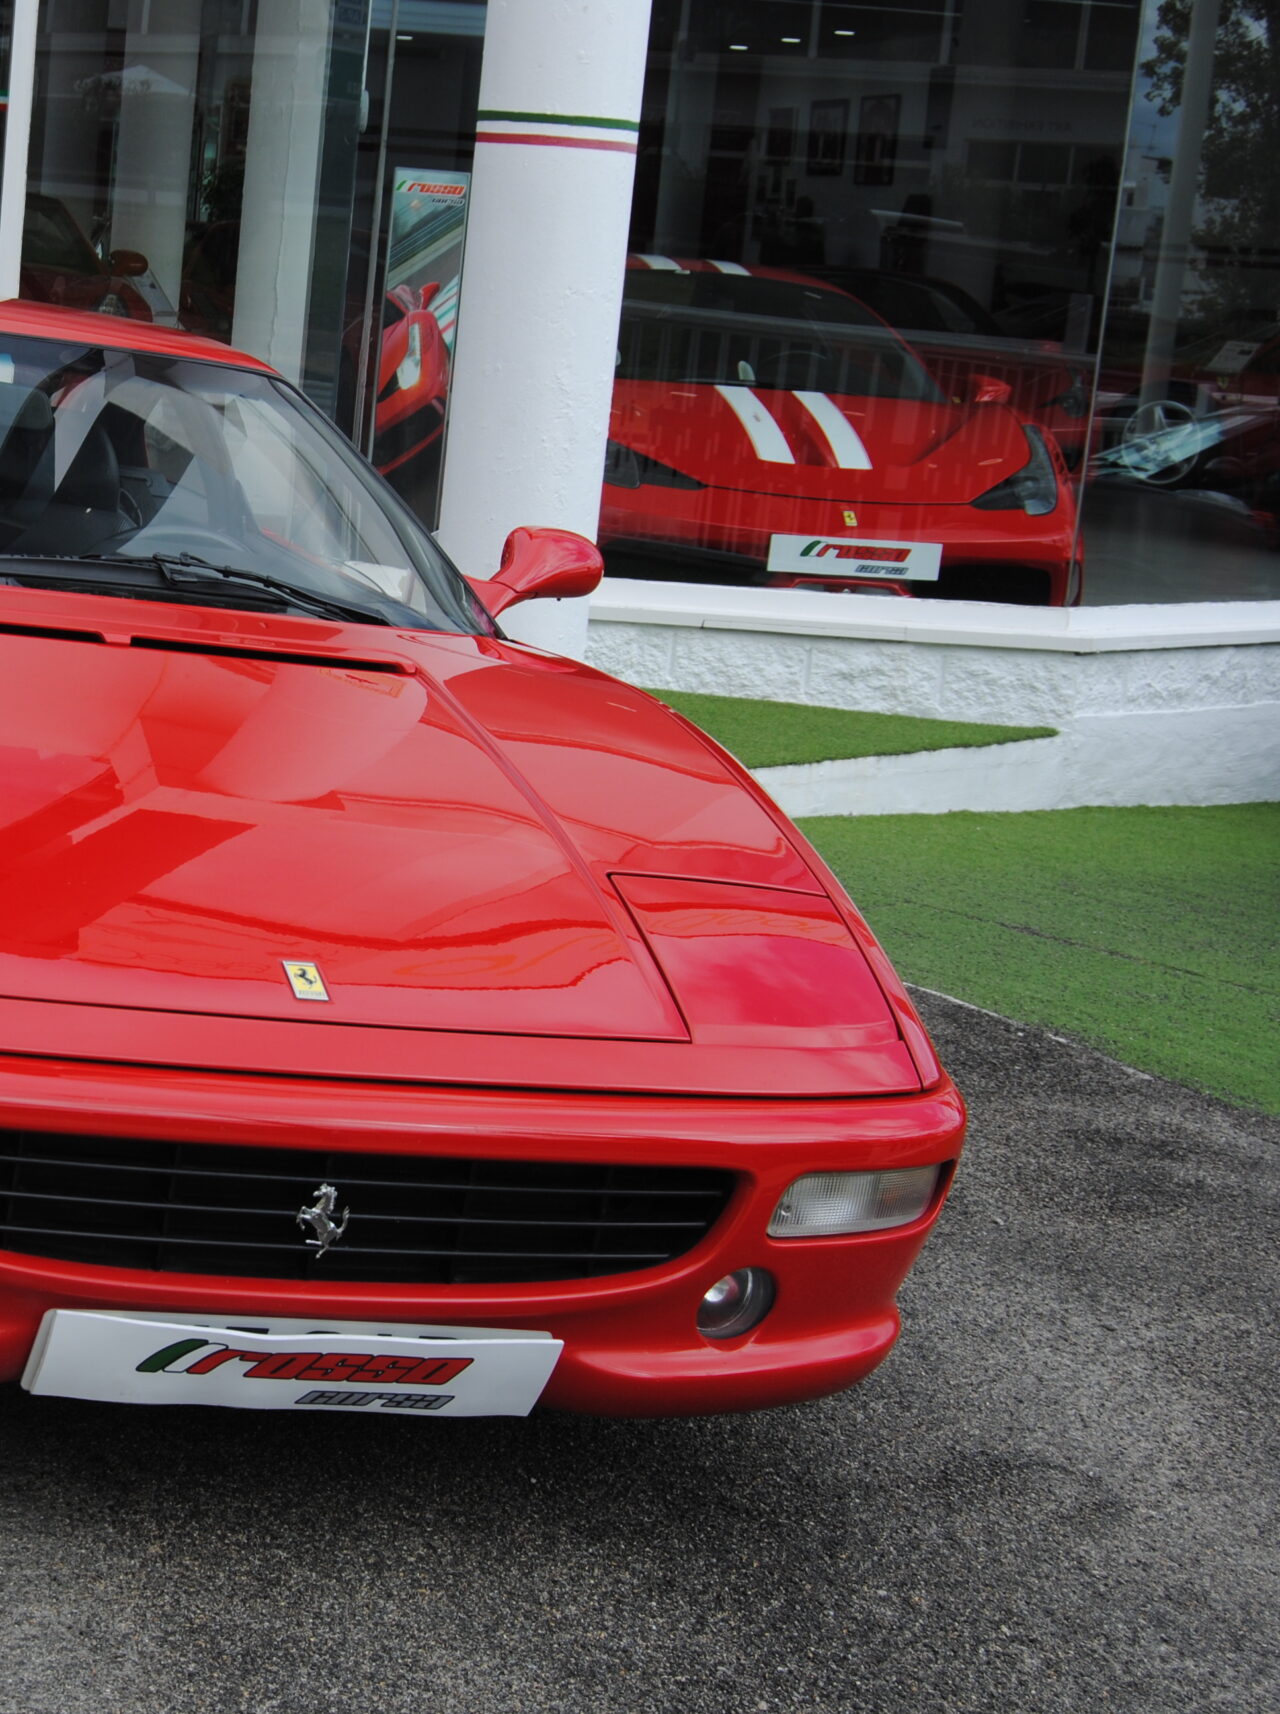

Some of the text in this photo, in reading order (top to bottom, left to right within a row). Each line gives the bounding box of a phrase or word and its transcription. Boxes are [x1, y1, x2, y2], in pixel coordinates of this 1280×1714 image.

[816, 544, 912, 562] rosso
[187, 1348, 475, 1385] rosso
[294, 1390, 456, 1410] corsa
